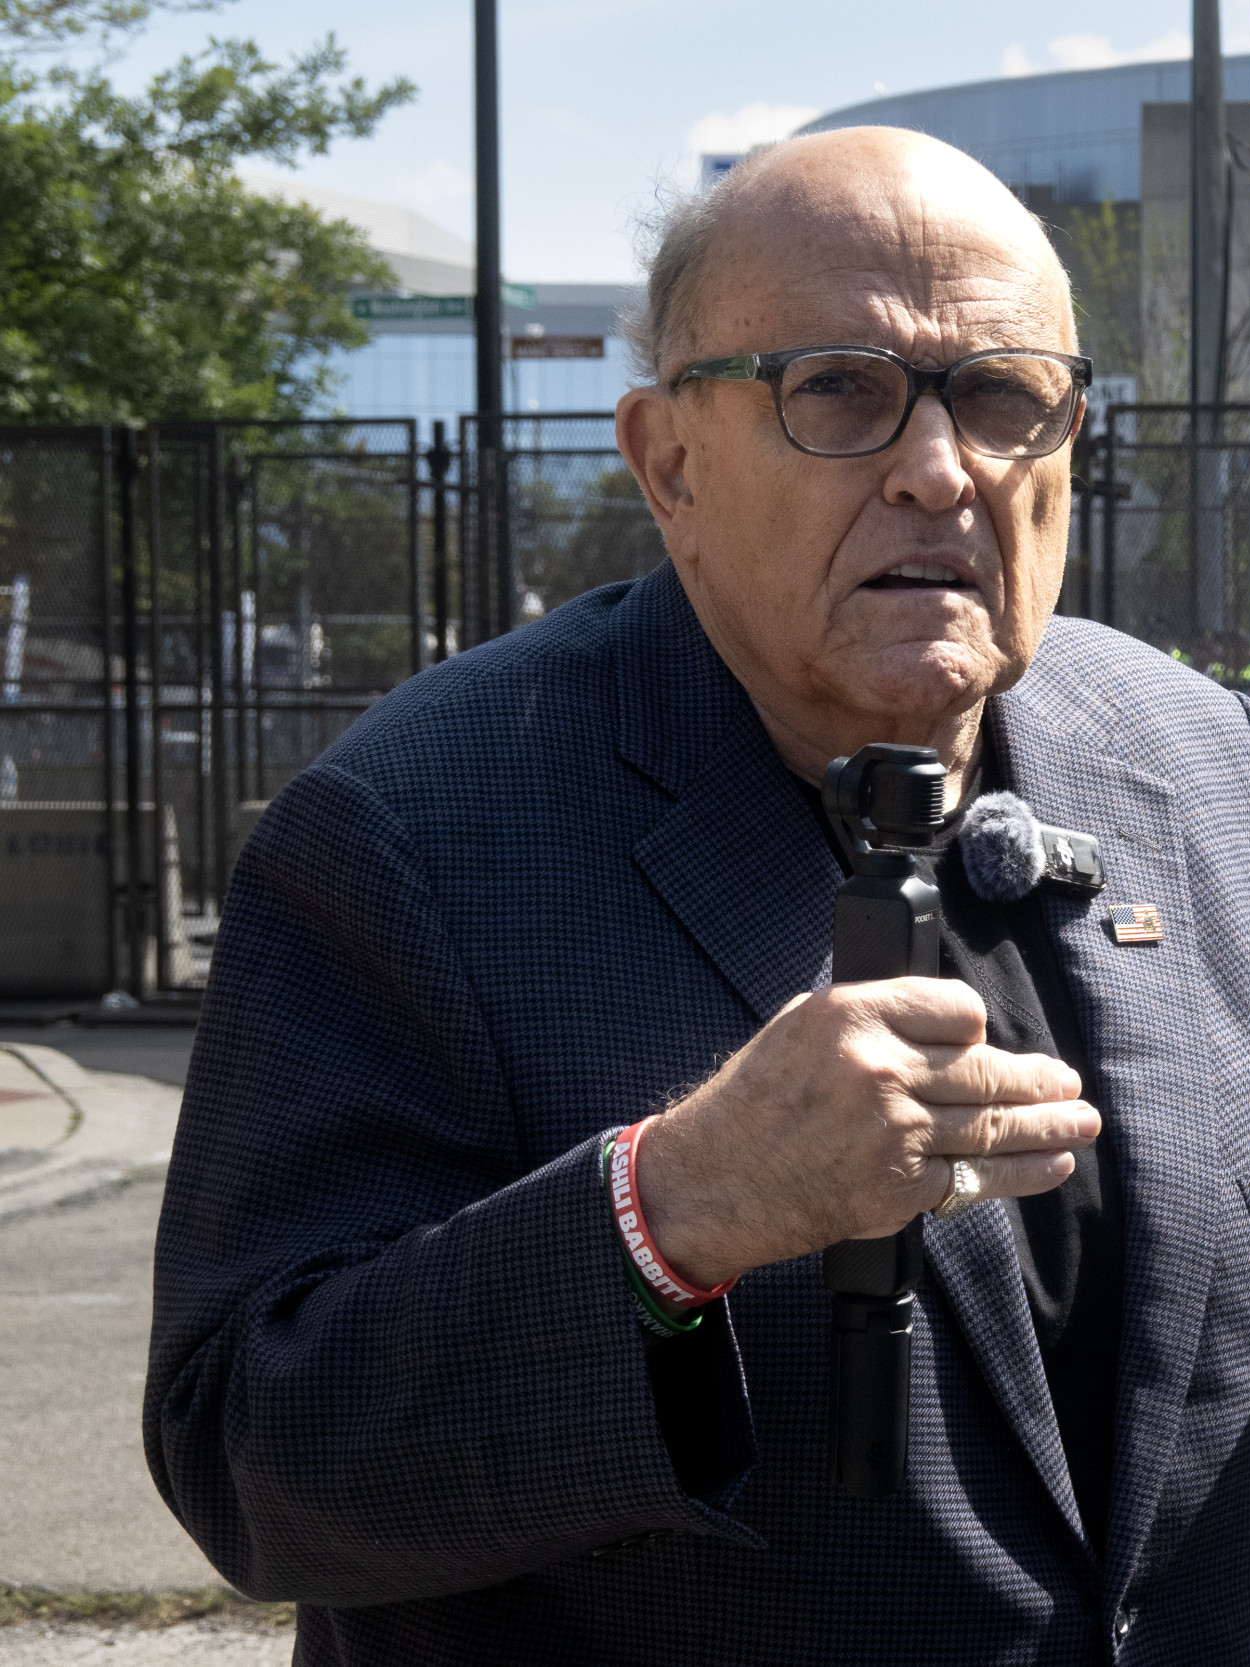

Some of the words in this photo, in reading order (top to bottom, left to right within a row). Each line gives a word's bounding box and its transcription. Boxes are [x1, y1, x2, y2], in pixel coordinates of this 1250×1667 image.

[915, 913, 930, 923] POCKET
[611, 1142, 633, 1210] ASHLI
[618, 1210, 695, 1303] BABBITT
